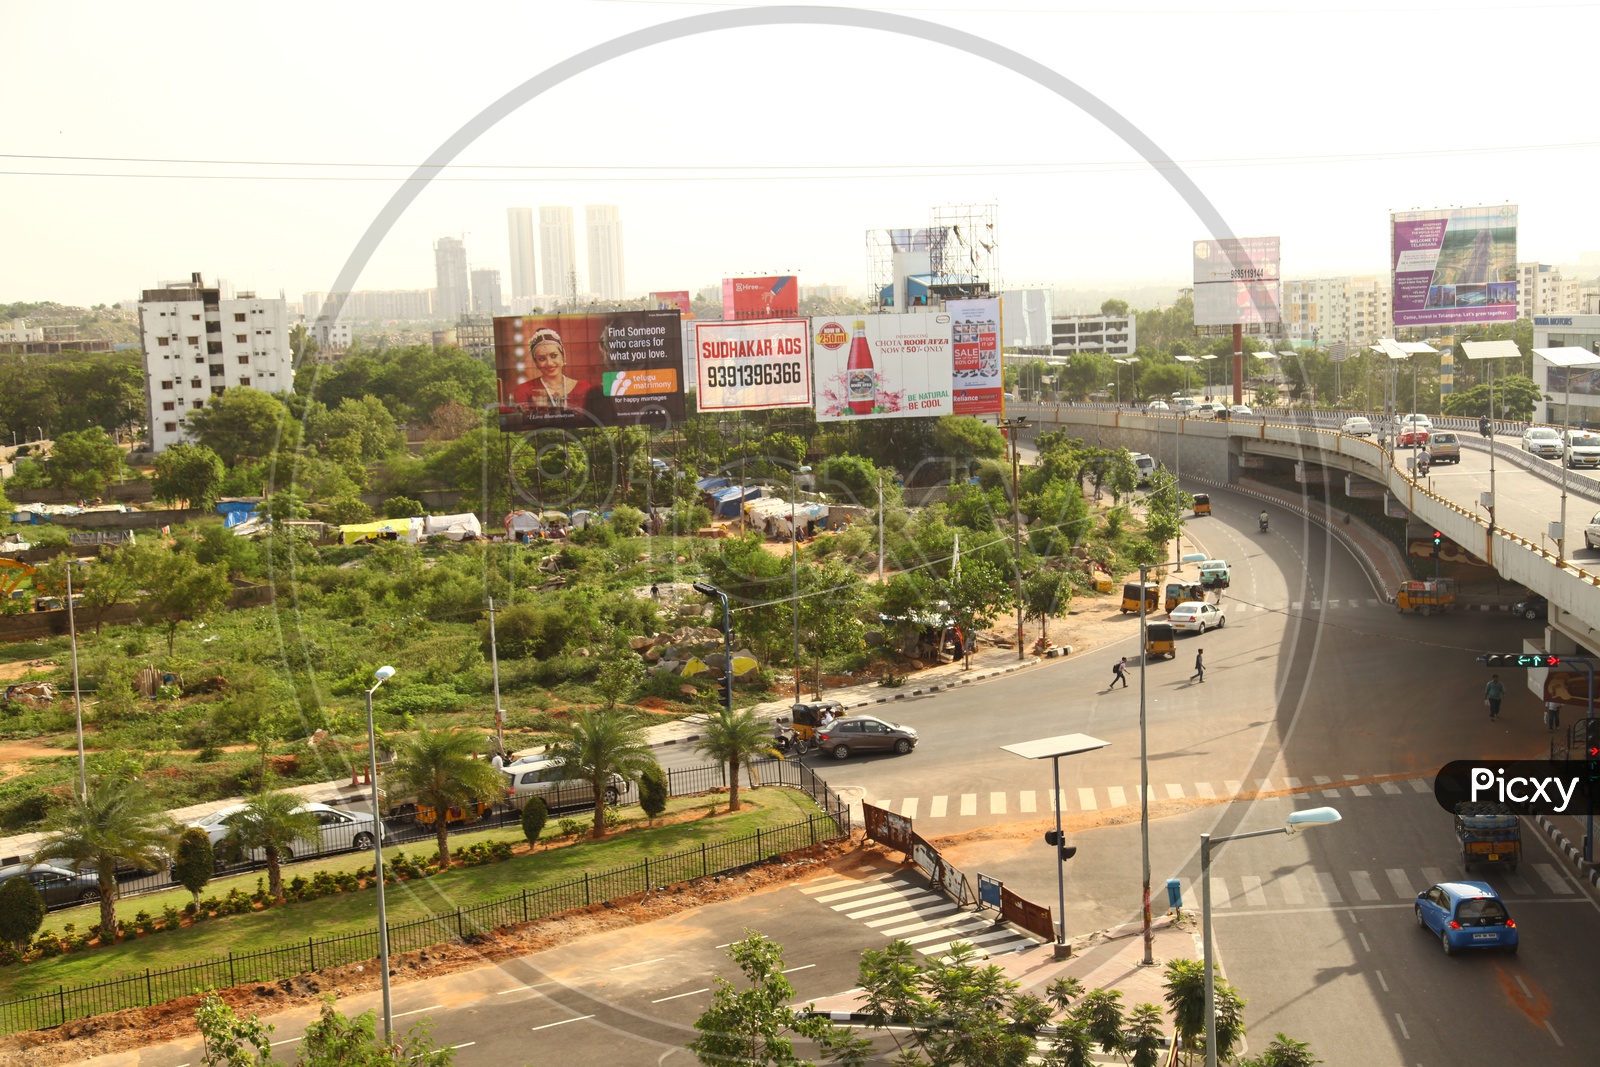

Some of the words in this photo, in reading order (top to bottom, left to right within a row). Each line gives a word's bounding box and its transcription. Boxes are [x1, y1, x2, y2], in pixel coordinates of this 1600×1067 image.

[1534, 317, 1550, 326] TATA
[1550, 317, 1573, 326] MOTORS
[608, 327, 625, 338] Find
[627, 326, 666, 336] Someone
[609, 340, 626, 349] who
[628, 340, 651, 349] cares
[653, 338, 664, 347] for
[702, 339, 773, 359] SUDHAKAR
[777, 337, 802, 355] ADS
[875, 339, 902, 347] CHOTA
[923, 345, 944, 353] ONLY
[954, 347, 979, 358] SALE
[609, 352, 630, 361] what
[631, 352, 647, 362] you
[648, 349, 668, 359] love.
[633, 374, 656, 383] telugu
[707, 362, 801, 388] 9391396366
[633, 380, 672, 390] matrimony
[614, 395, 623, 403] for
[623, 396, 640, 404] happy
[640, 394, 667, 402] marriages
[908, 394, 918, 402] BE
[918, 390, 950, 400] NATURAL
[953, 394, 979, 402] Reliance
[908, 402, 919, 410] BE
[920, 399, 942, 409] COOL
